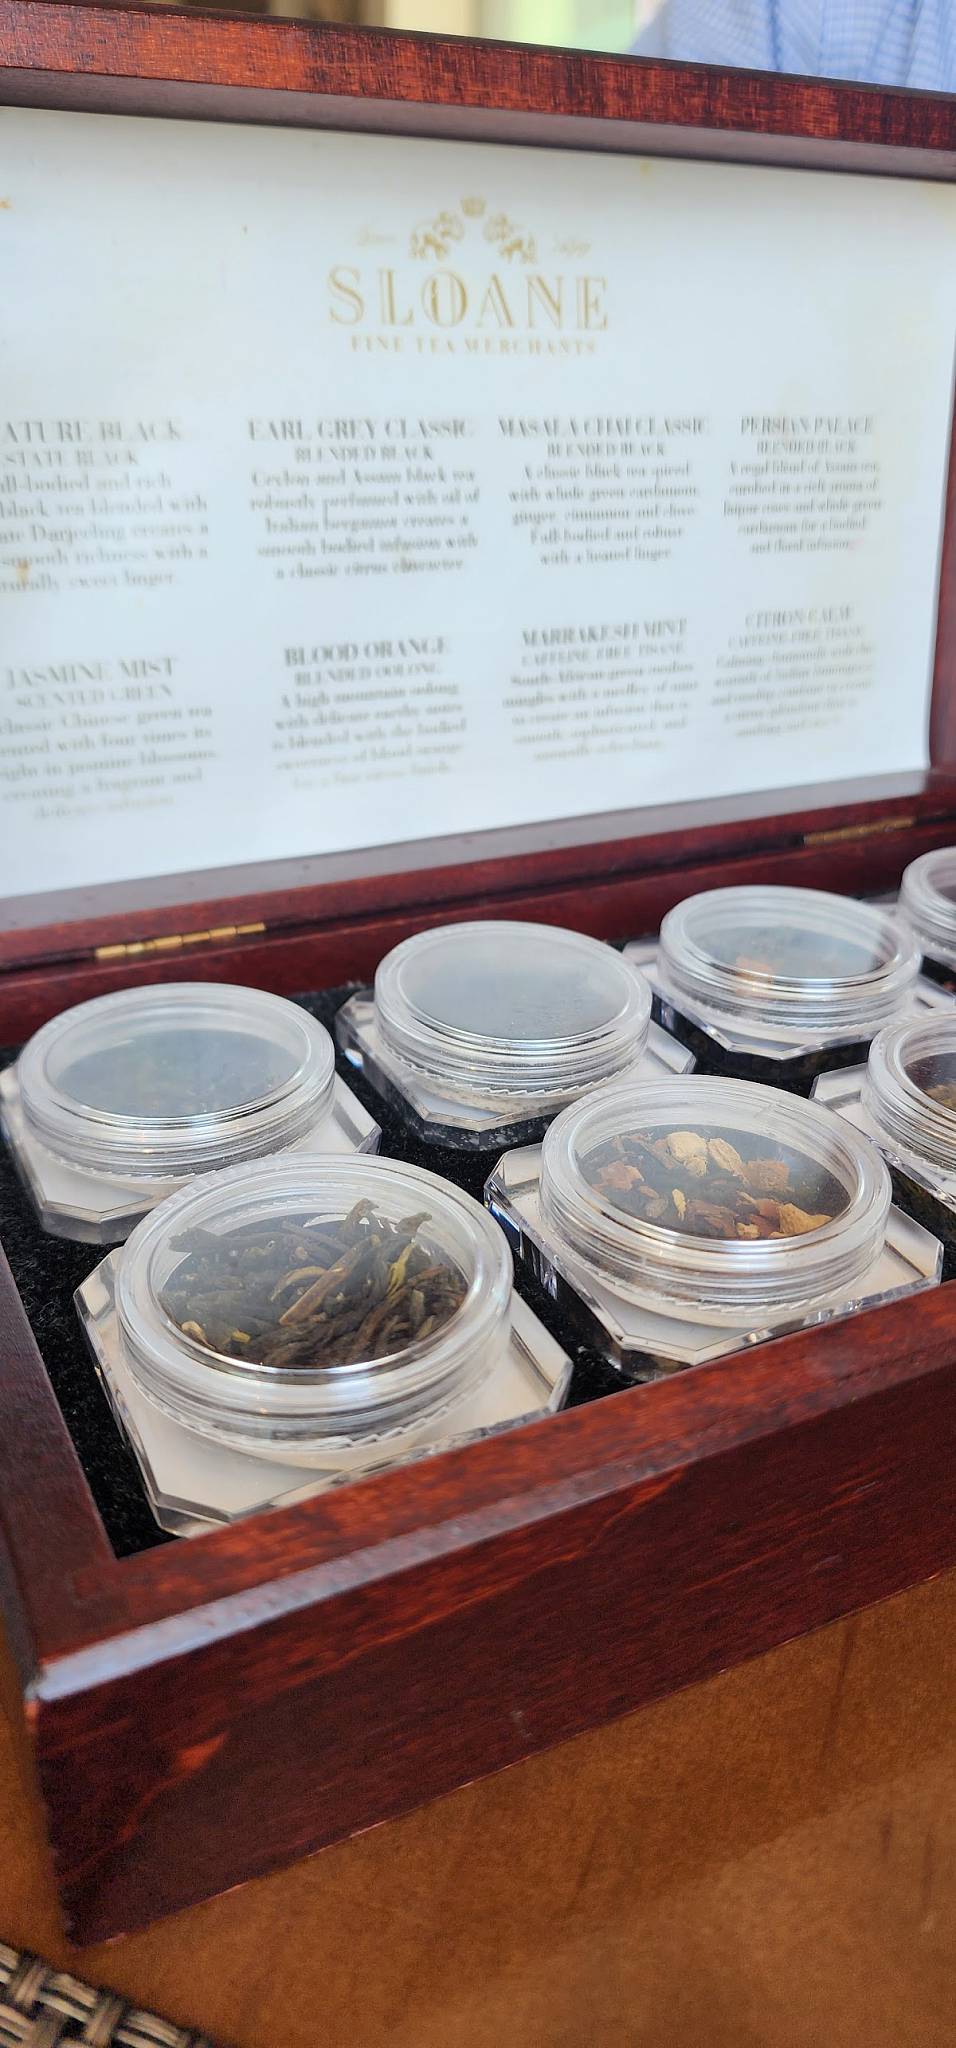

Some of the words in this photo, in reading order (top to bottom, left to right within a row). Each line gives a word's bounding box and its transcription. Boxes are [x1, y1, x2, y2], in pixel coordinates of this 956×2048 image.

[326, 264, 609, 330] SLOANE
[350, 335, 401, 352] FINE
[416, 336, 456, 354] TEA
[464, 337, 596, 356] MERCHANTS
[98, 420, 183, 442] BLACK
[246, 418, 308, 441] EARL
[316, 417, 376, 440] GREY
[383, 416, 472, 439] CLASSIC
[283, 643, 359, 667] BLOOD
[4, 662, 112, 689] JASMINE
[119, 657, 177, 678] MIST
